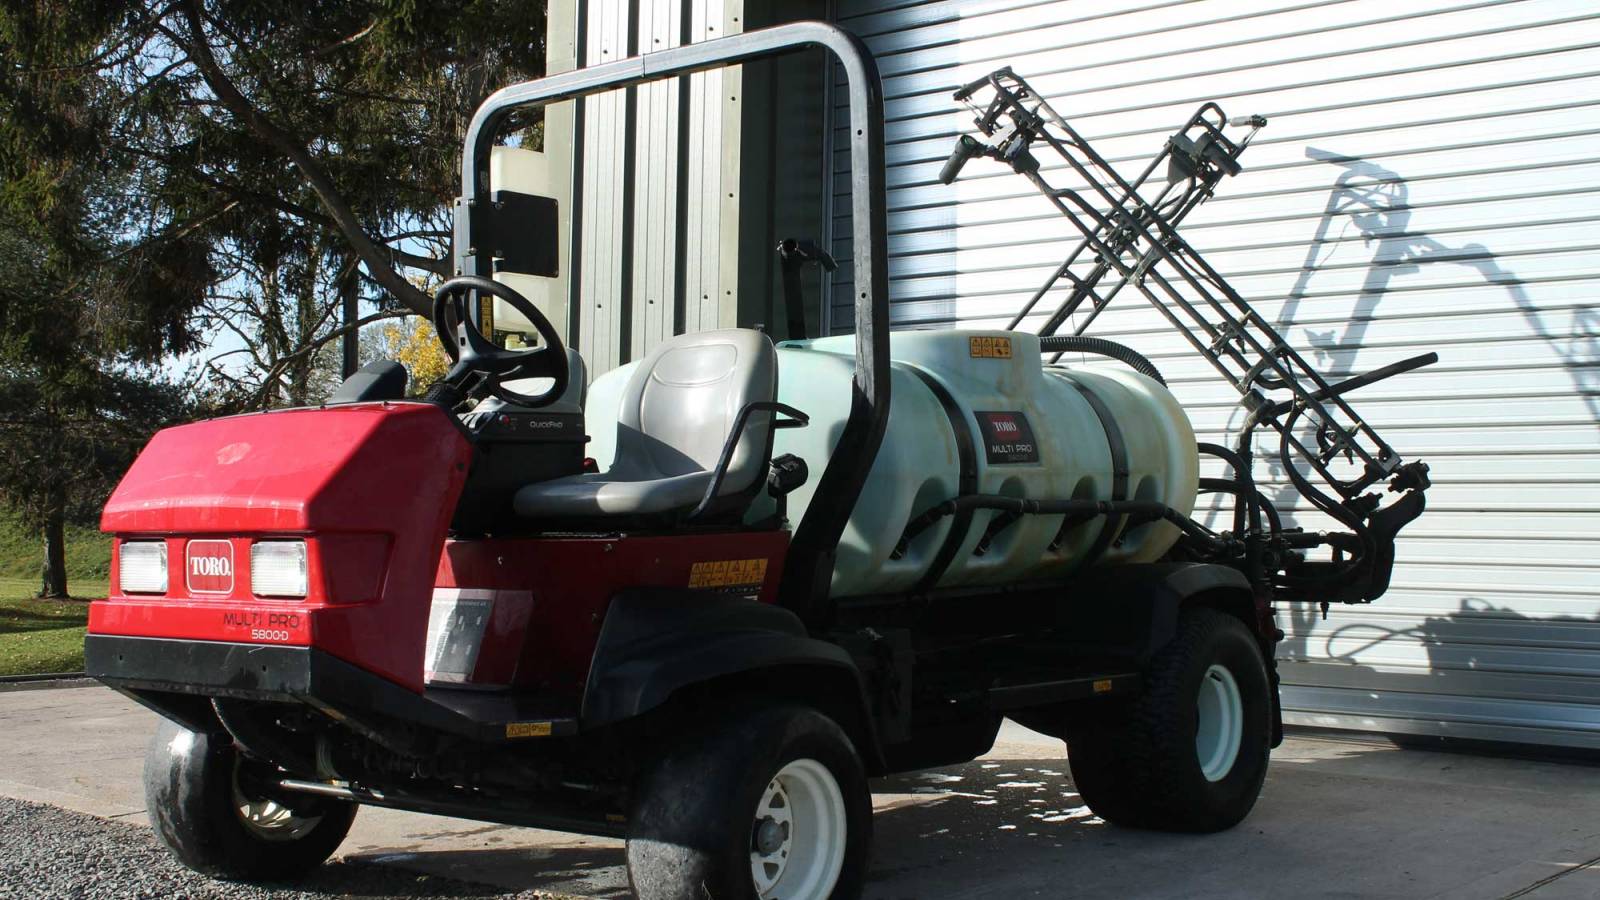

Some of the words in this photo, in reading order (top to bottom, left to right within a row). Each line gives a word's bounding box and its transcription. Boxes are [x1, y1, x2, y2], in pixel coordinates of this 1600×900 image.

[992, 445, 1014, 453] MULTI
[1016, 444, 1032, 453] PRO
[224, 612, 262, 626] MULTI
[268, 613, 300, 628] PRO
